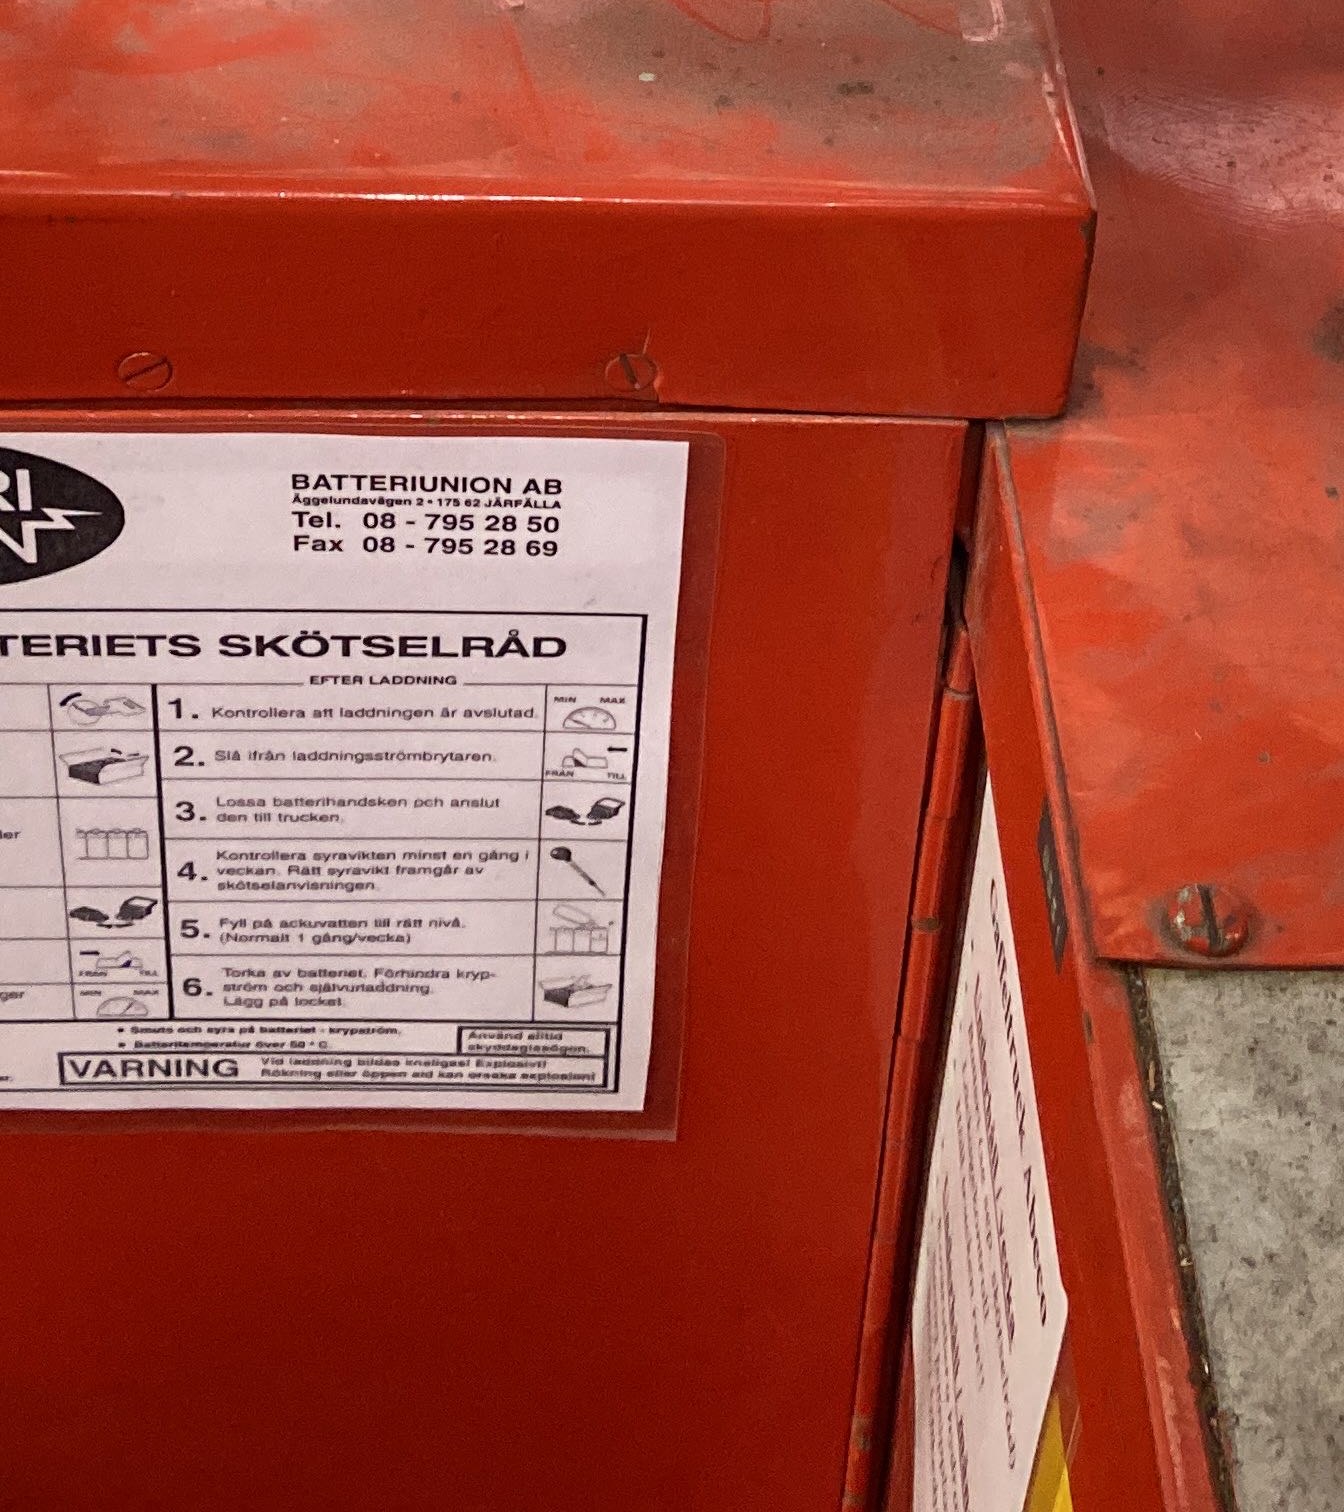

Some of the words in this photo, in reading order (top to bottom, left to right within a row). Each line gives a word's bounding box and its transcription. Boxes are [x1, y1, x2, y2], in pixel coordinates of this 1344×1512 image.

[291, 473, 512, 493] BATTERIUNION
[522, 477, 563, 495] AB
[415, 498, 425, 507] 2
[436, 497, 461, 508] 175
[291, 510, 341, 529] Tel.
[362, 511, 397, 530] 08
[424, 513, 475, 532] 795
[484, 514, 518, 533] 28
[526, 515, 560, 533] 50
[293, 535, 344, 552] Fax
[362, 536, 396, 554] 08
[423, 536, 474, 555] 795
[483, 538, 516, 556] 28
[525, 539, 558, 557] 69
[218, 629, 567, 658] SKÖTSELRÅD
[309, 675, 364, 685] EFTER
[368, 675, 458, 685] LADDNING
[167, 697, 199, 720] 1.
[211, 706, 306, 718] Kontrollera
[312, 708, 334, 718] att
[339, 707, 435, 721] laddningen
[439, 707, 458, 718] är
[173, 745, 205, 768] 2.
[214, 750, 241, 762] Slå
[248, 750, 286, 762] ifrån
[175, 800, 207, 823] 3.
[215, 796, 267, 808] Lossa
[272, 795, 408, 808] batterihandsken
[450, 796, 501, 808] anslut
[215, 813, 248, 823] den
[253, 812, 272, 823] till
[176, 860, 209, 882] 4.
[215, 849, 307, 862] Kontrollera
[312, 850, 397, 864] syravikten
[402, 850, 448, 861] minst
[452, 852, 473, 861] en
[478, 850, 520, 864] gång
[524, 850, 530, 861] i
[287, 865, 322, 877] Rätt
[326, 865, 390, 878] syravikt
[395, 864, 460, 878] framgår
[464, 867, 484, 875] av
[179, 918, 211, 941] 5.
[218, 918, 247, 931] Fyll
[252, 918, 274, 931] på
[279, 918, 369, 931] ackuvatten
[373, 917, 391, 928] till
[396, 917, 424, 928] rätt
[219, 932, 291, 946] (Normalt
[297, 933, 304, 943] 1
[182, 976, 214, 998] 6.
[221, 967, 267, 979] Torka
[272, 970, 292, 980] av
[456, 969, 496, 982] kryp-
[223, 996, 264, 1010] Lägg
[268, 996, 289, 1009] på
[67, 1058, 240, 1080] VARNING
[989, 878, 1026, 1157] Gaffeltruck
[1023, 1165, 1047, 1327] Abeco
